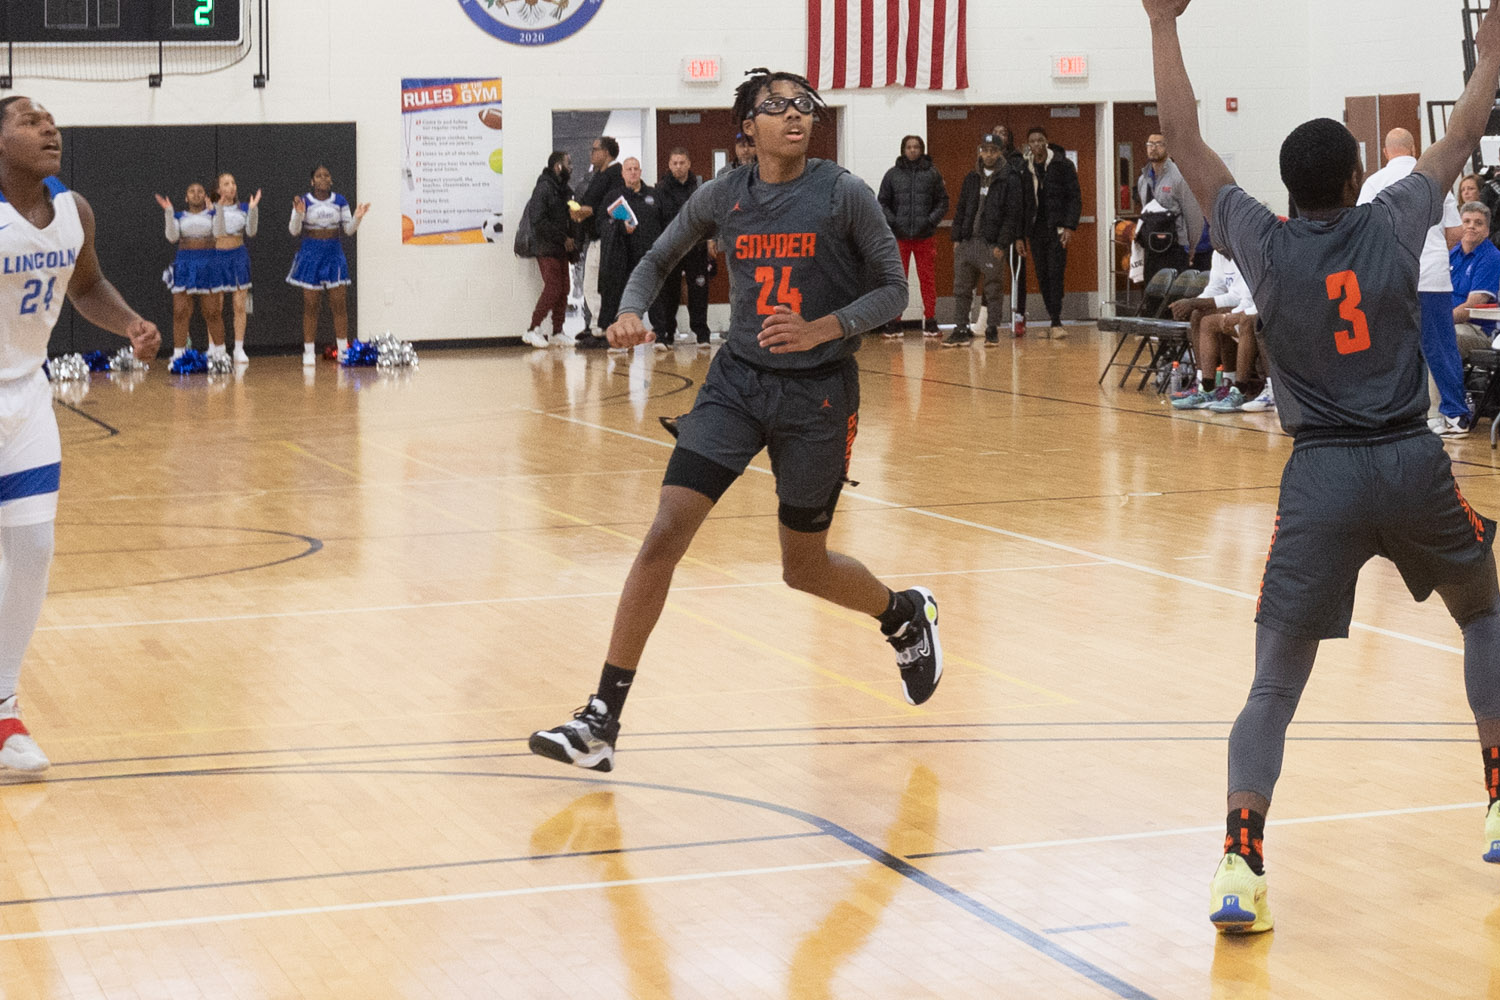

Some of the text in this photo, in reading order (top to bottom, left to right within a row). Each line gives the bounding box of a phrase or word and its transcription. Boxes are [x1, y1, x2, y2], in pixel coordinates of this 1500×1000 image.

[519, 32, 545, 43] 2020
[691, 59, 715, 78] EXIT
[1060, 56, 1083, 74] EXIT
[403, 86, 497, 108] RULES GYM
[735, 232, 817, 260] SNYDER
[3, 248, 76, 275] LINCOLN
[754, 266, 803, 316] 24
[1325, 269, 1371, 355] 3
